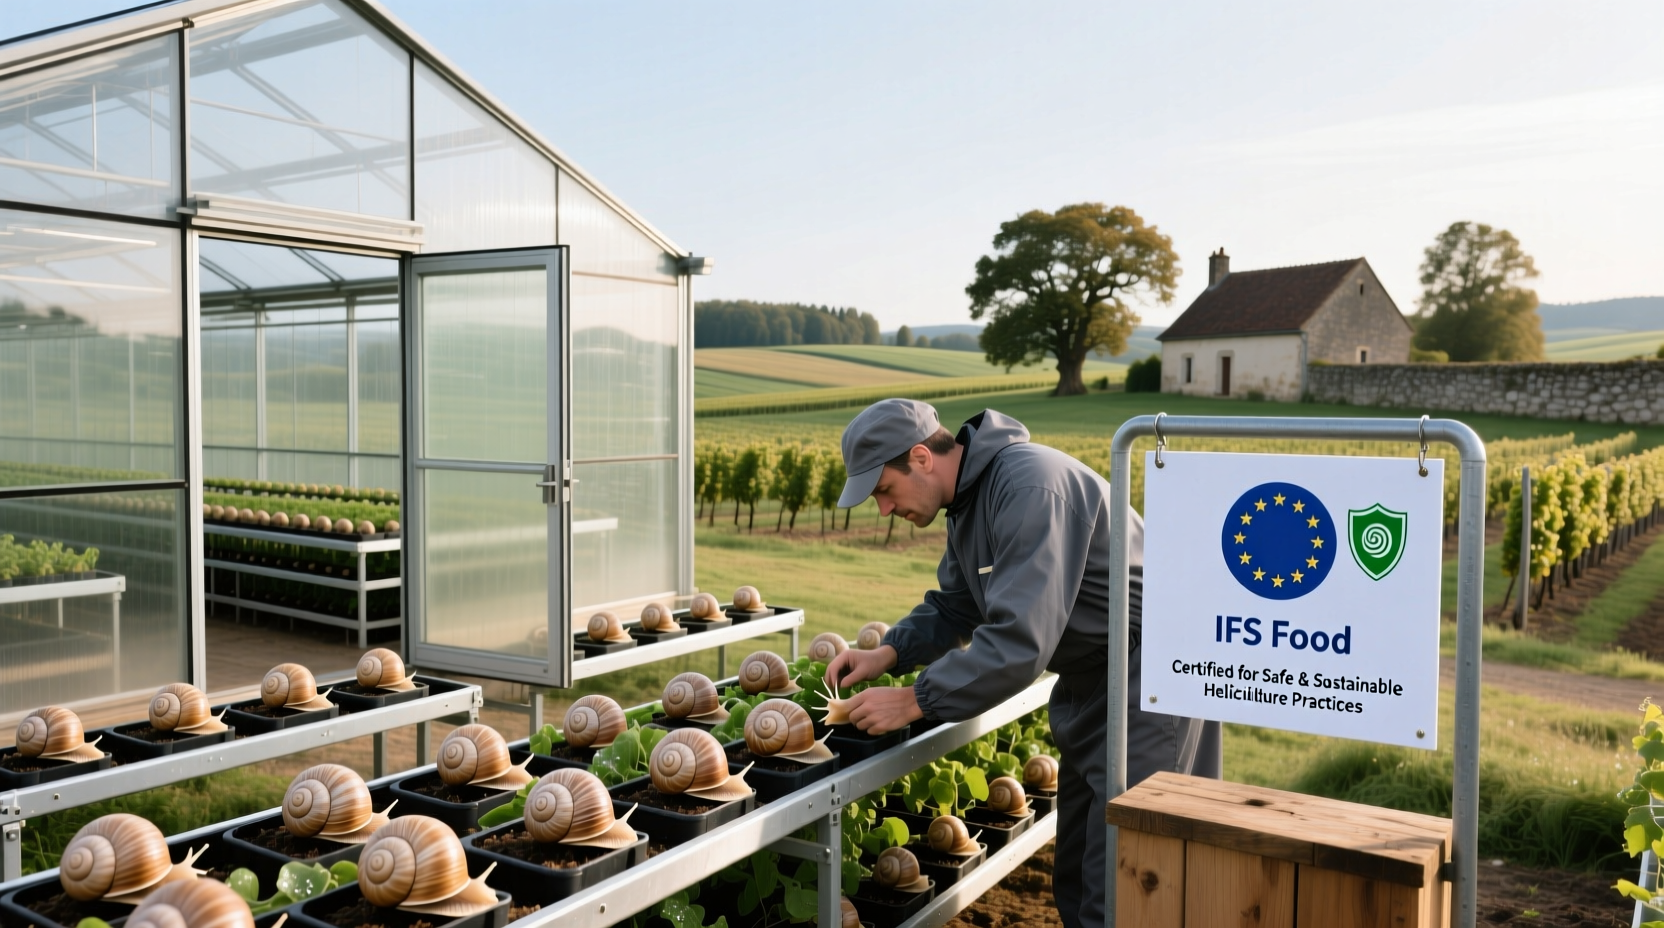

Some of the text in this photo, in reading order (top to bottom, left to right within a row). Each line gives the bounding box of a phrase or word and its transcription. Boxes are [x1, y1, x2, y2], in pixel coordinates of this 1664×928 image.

[1215, 614, 1352, 655] IFS Food
[1171, 659, 1234, 680] Certified
[1237, 664, 1260, 682] for
[1263, 668, 1294, 687] Safe
[1297, 671, 1310, 687] &
[1292, 691, 1363, 714] Practices
